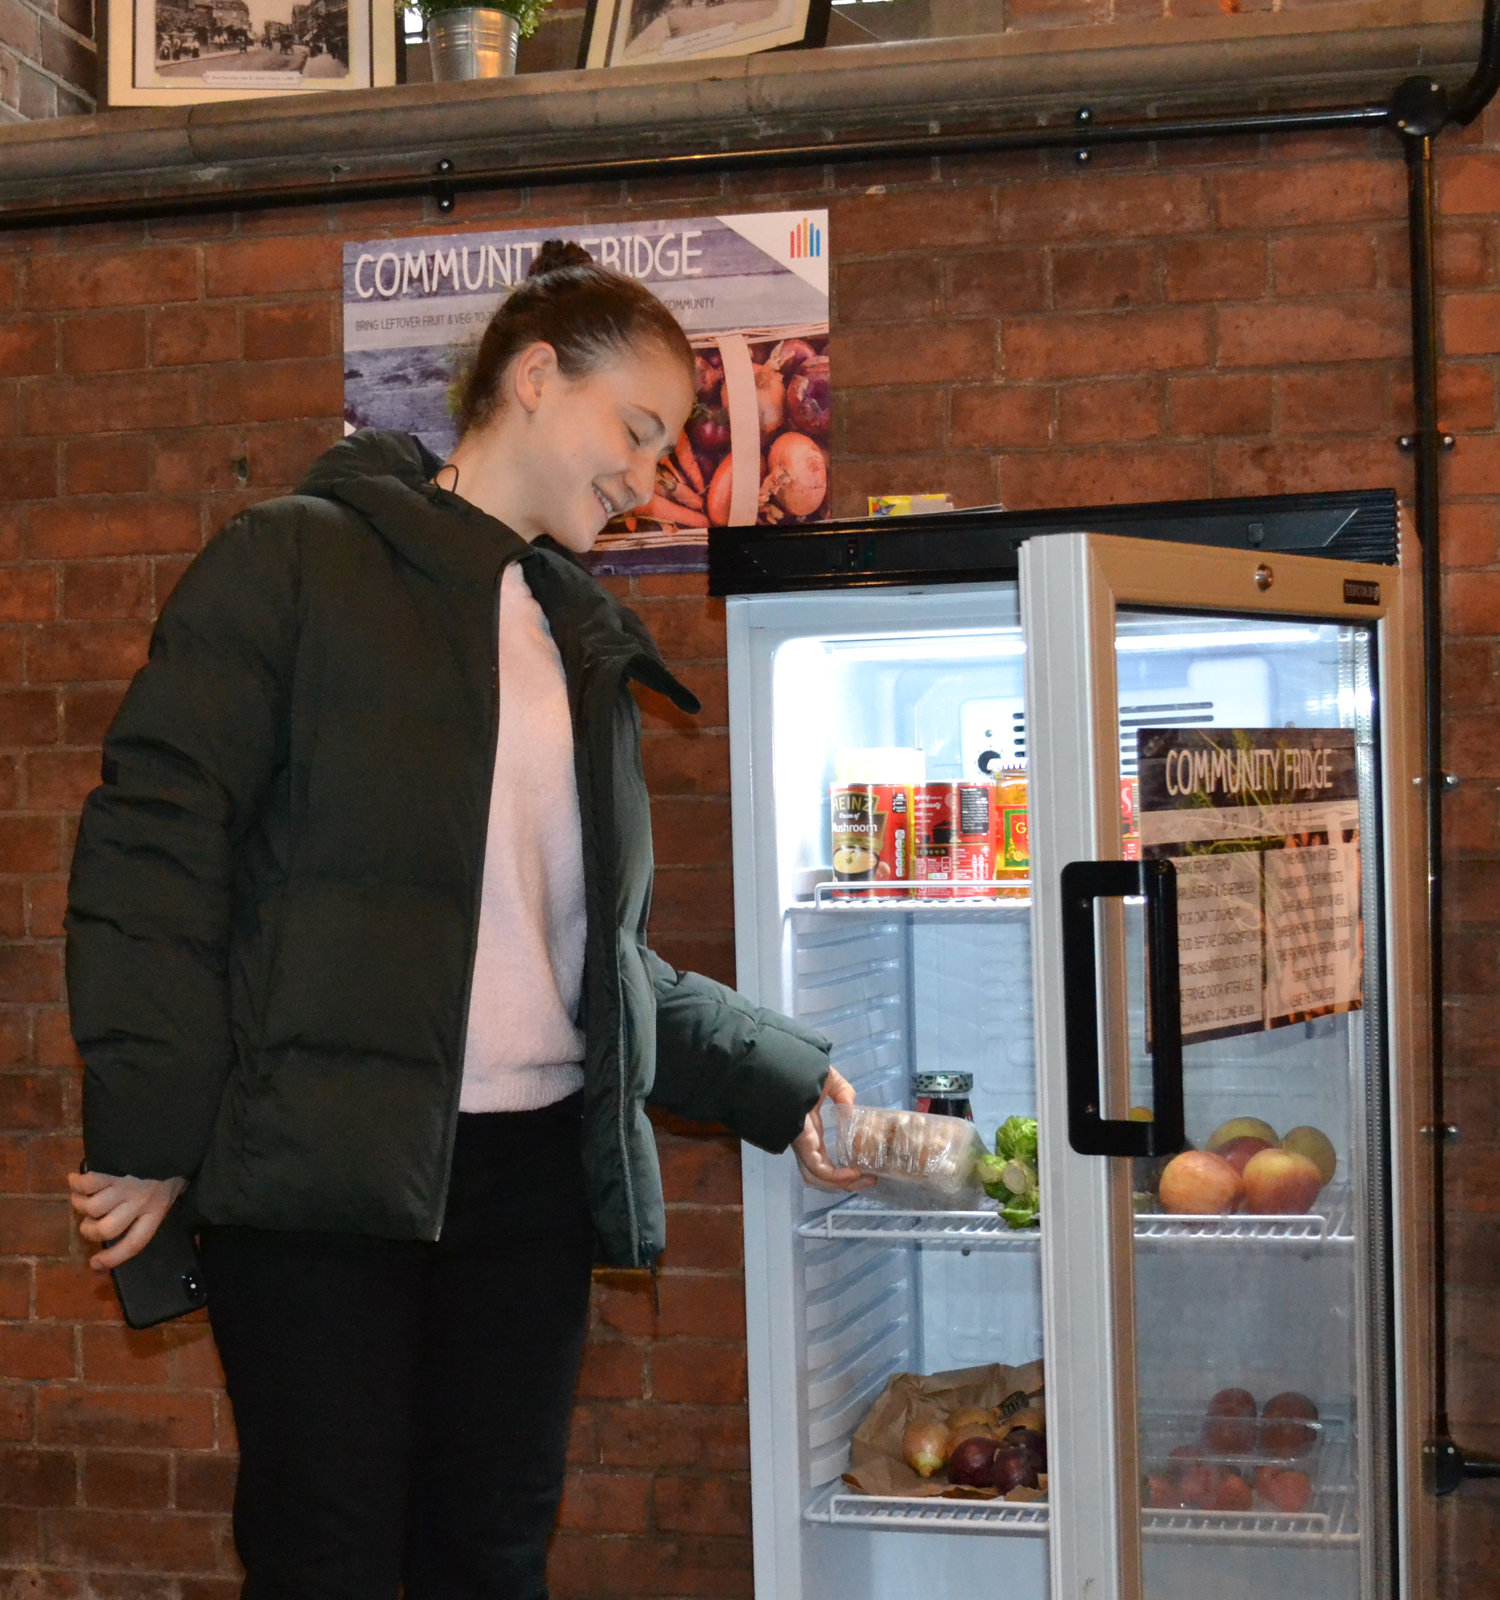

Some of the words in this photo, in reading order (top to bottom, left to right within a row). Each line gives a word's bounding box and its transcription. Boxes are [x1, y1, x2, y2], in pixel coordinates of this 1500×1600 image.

[355, 241, 550, 298] COMMUNIT
[355, 318, 379, 331] BRING
[381, 315, 420, 330] LEFTOVER
[422, 314, 444, 328] FRUIT
[455, 312, 471, 325] VEG
[1166, 748, 1281, 796] COMMUNITY
[1284, 748, 1334, 791] FRIDGE
[833, 795, 874, 812] HEINZ
